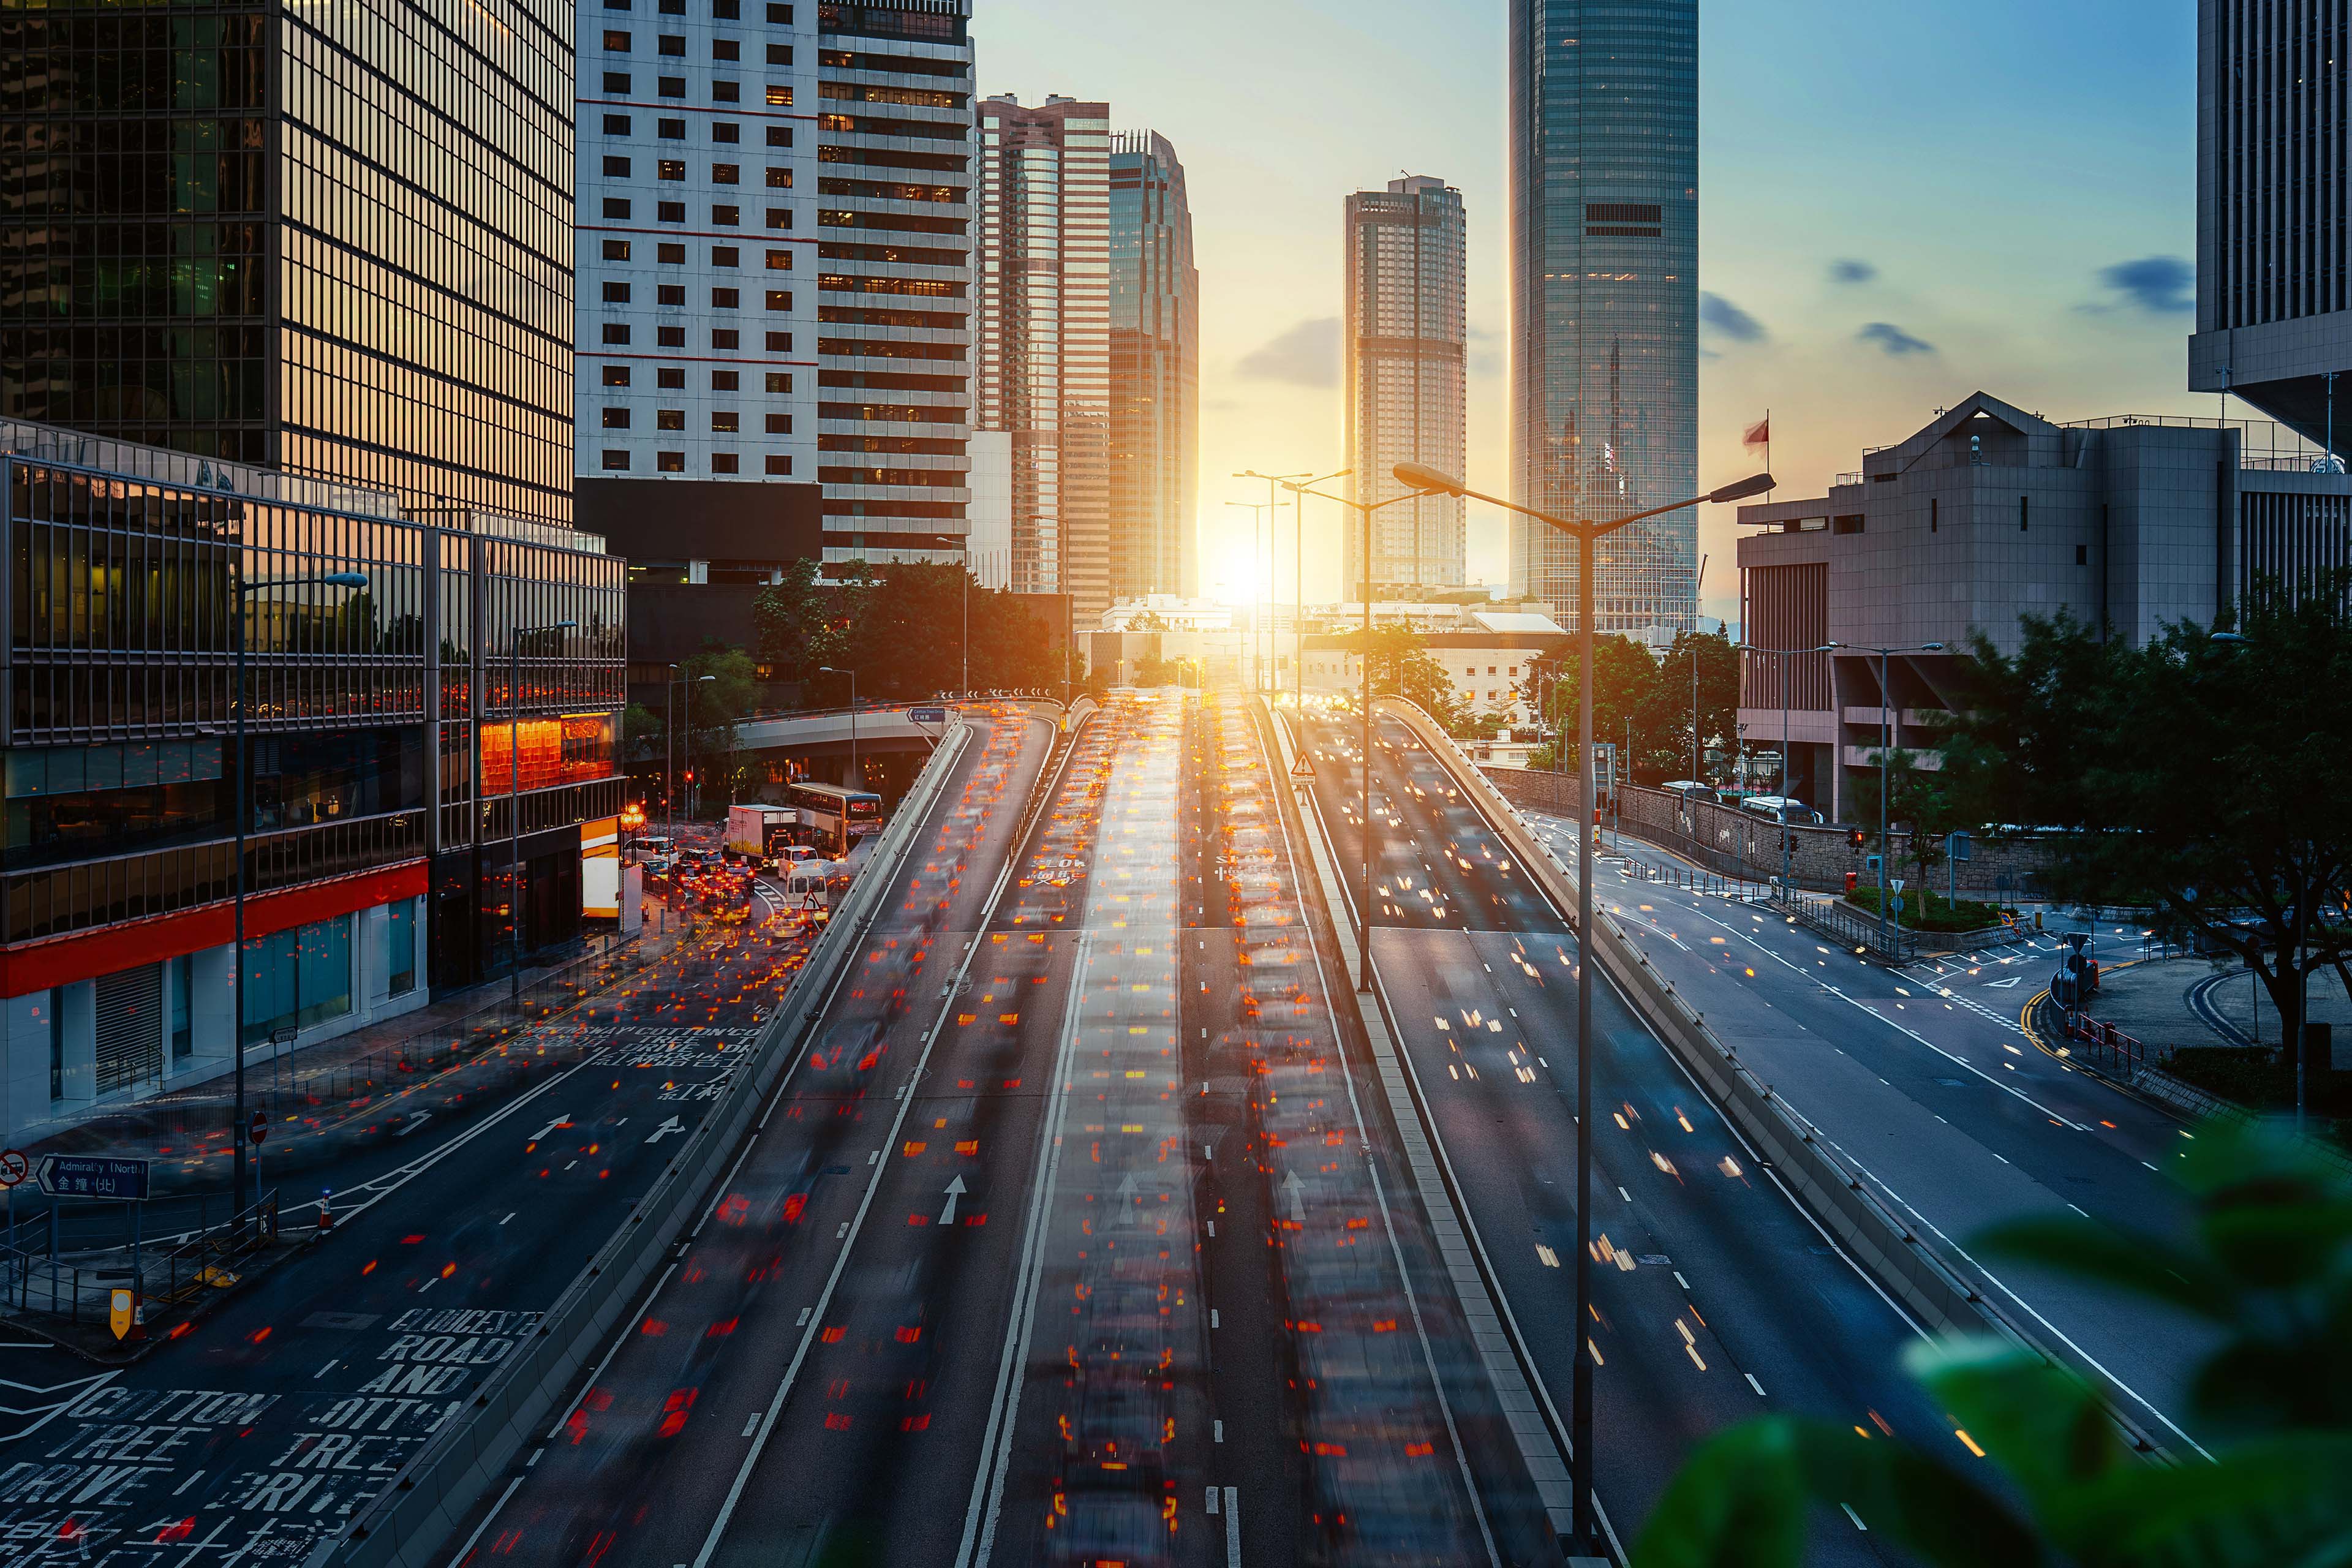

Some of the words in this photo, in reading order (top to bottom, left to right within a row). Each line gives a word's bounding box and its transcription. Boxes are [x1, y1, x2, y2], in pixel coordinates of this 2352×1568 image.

[635, 1027, 726, 1036] COTTON
[639, 1036, 704, 1044] TREE
[620, 1044, 700, 1053] DRIVE
[59, 1161, 104, 1174] Admiralty
[110, 1162, 145, 1175] (North)
[376, 1335, 514, 1365] ROAD
[356, 1363, 472, 1395] AND
[67, 1386, 283, 1426] COTTON
[45, 1423, 213, 1462] TREE
